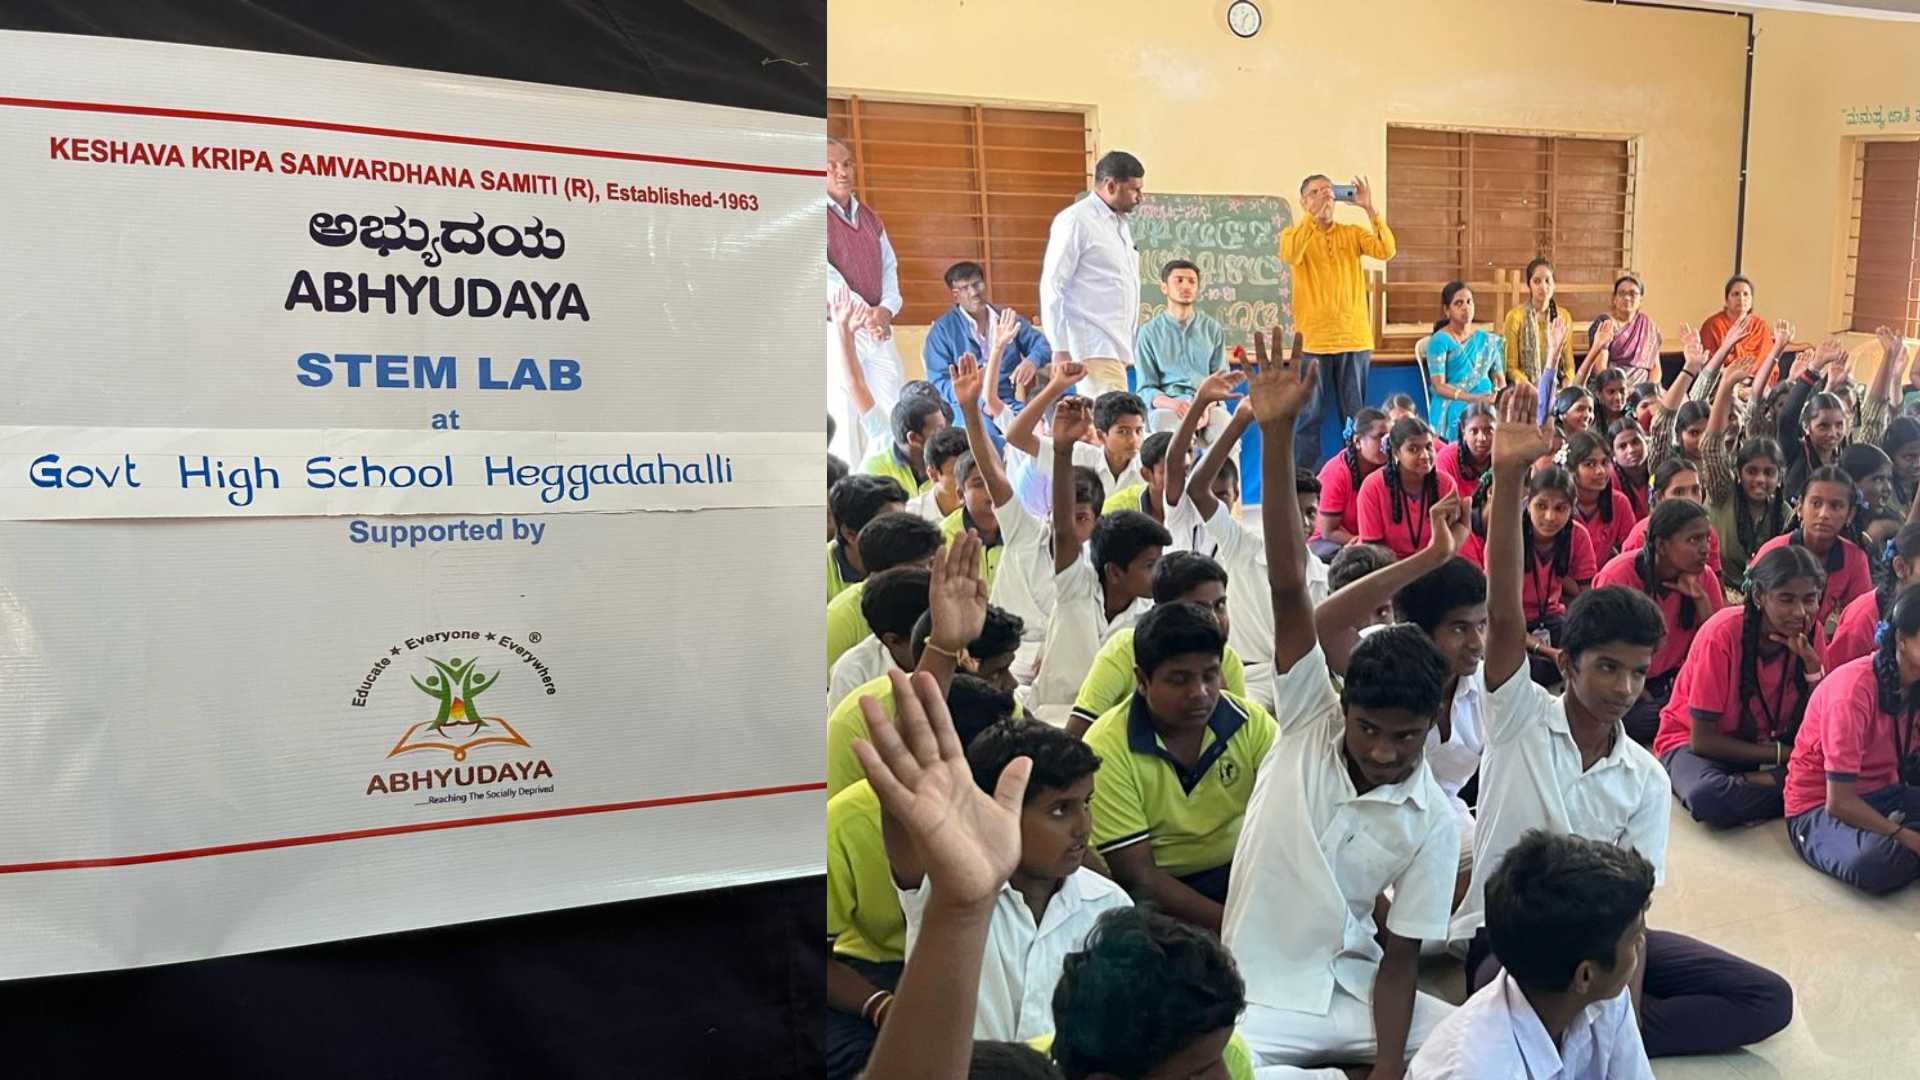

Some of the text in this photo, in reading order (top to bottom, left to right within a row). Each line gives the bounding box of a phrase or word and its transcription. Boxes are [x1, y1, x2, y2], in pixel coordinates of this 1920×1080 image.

[50, 137, 759, 212] KESHAVA KRIPA SAMVARDHANA SAMITI (R), Established-1963
[308, 205, 566, 268] ಅಭ್ಯುದಯ
[284, 269, 591, 322] ABHYUDAYA
[296, 352, 583, 391] STEM LAB
[431, 409, 461, 431] at
[29, 453, 733, 506] Govt High School Heggadahalli
[349, 518, 546, 549] Supported by
[351, 656, 392, 708] Educate
[404, 630, 481, 651] Everyone
[497, 634, 557, 696] Everywhere
[366, 759, 554, 796] ABHYUDAYA
[469, 791, 484, 801] The
[486, 787, 517, 799] Socially
[518, 784, 555, 797] Deprived
